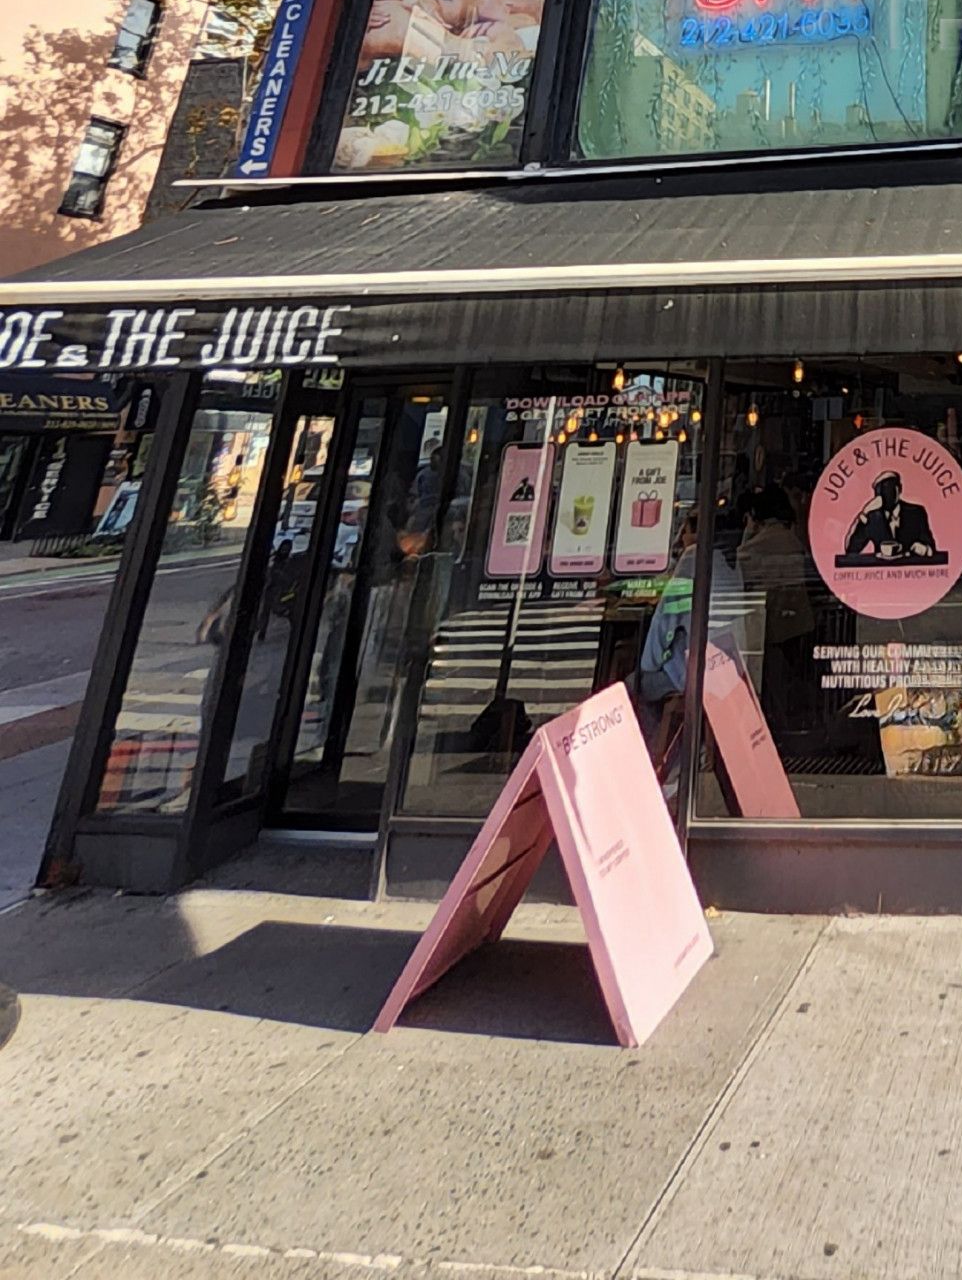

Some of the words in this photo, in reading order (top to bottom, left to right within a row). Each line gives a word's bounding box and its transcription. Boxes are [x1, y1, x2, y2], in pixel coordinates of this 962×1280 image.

[680, 8, 870, 46] 212-421-6035
[250, 4, 302, 156] CLEANERS
[358, 58, 390, 86] Ji
[392, 56, 426, 83] Li
[433, 51, 532, 83] Tui-Na
[352, 87, 526, 117] 212-421-6035
[0, 310, 63, 368] OE
[55, 345, 88, 367] &
[98, 309, 196, 367] THE
[200, 305, 351, 365] JUICE
[0, 393, 109, 411] EANERS
[569, 408, 604, 420] GFT
[656, 403, 690, 415] OE
[824, 460, 854, 501] JOE
[853, 448, 869, 466] &
[871, 437, 910, 458] THE
[913, 448, 960, 499] JUICE
[887, 570, 902, 579] AND
[904, 569, 926, 579] MUCH
[928, 568, 949, 578] MORE
[813, 646, 860, 660] SERVING
[862, 645, 886, 659] OUR
[831, 660, 861, 673] WITH
[863, 660, 910, 673] HEALTHY
[821, 675, 886, 688] NUTRITIOUS
